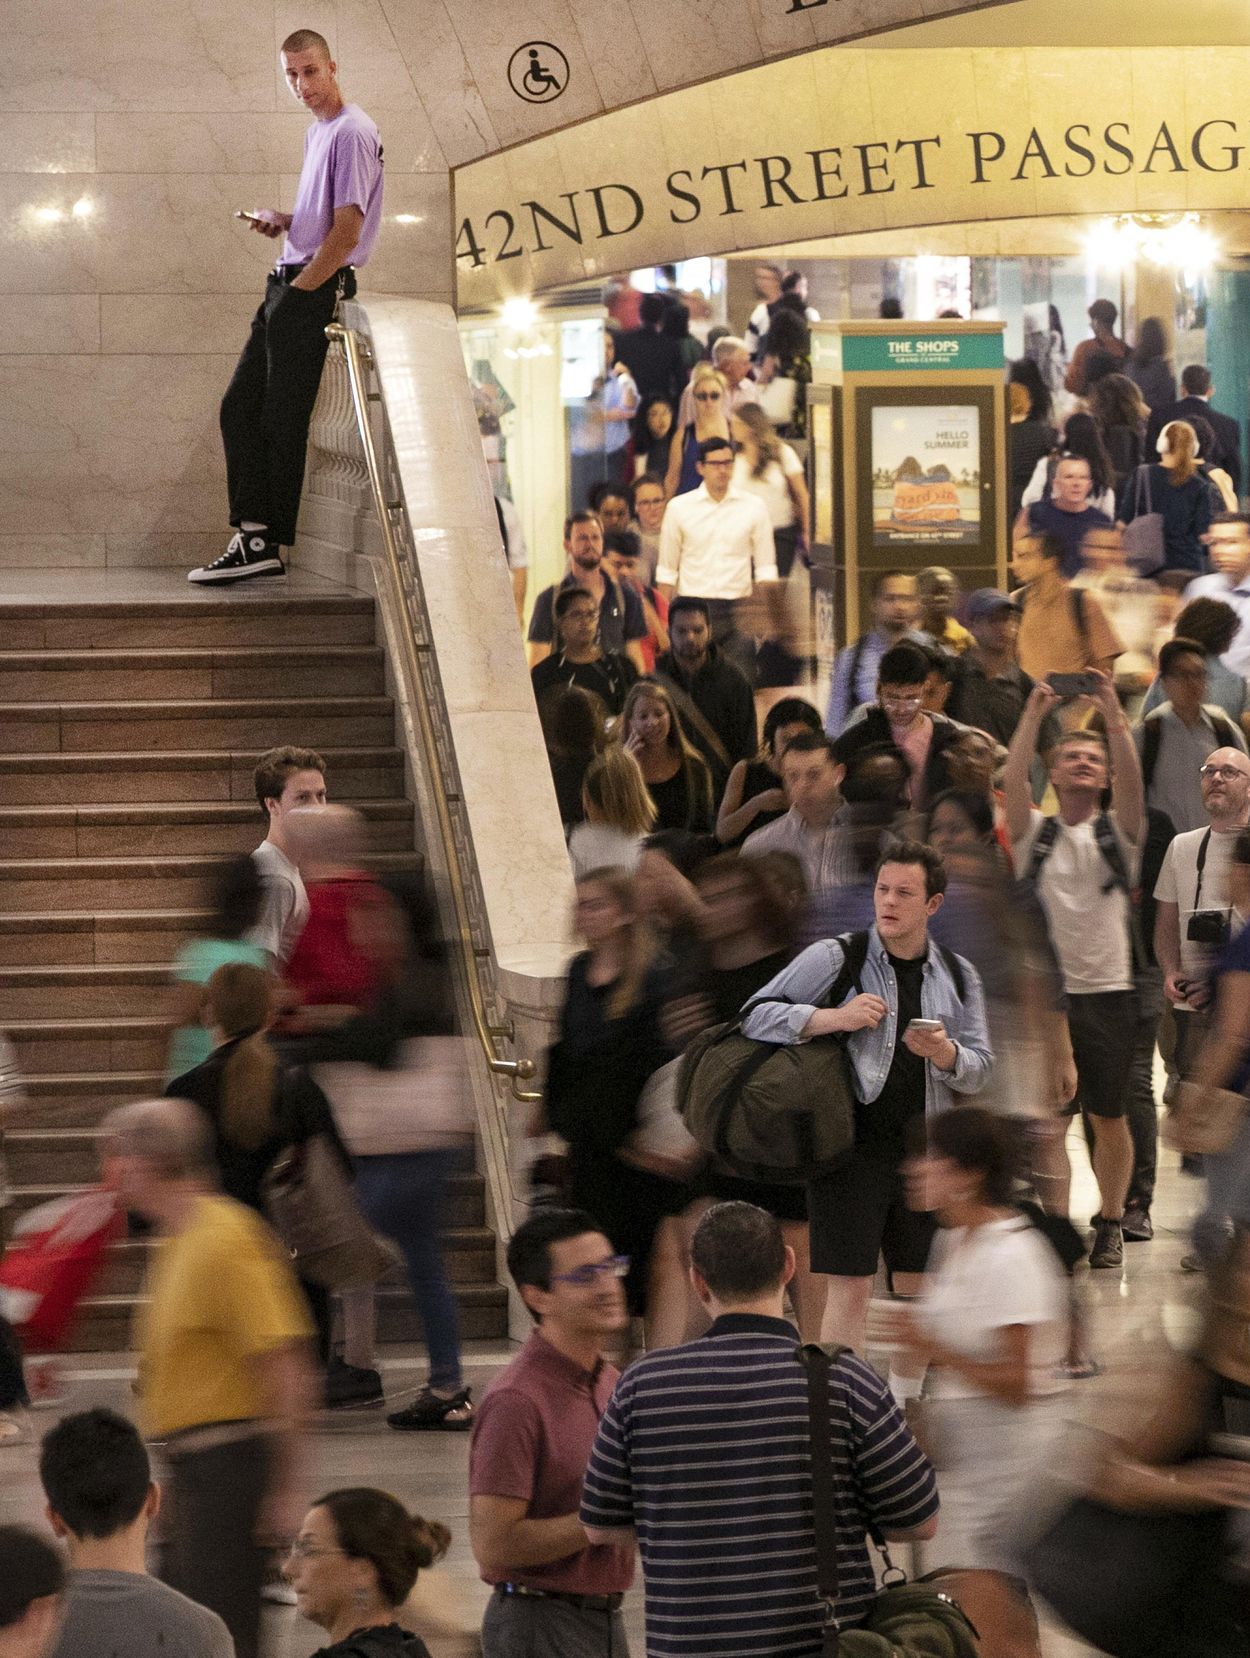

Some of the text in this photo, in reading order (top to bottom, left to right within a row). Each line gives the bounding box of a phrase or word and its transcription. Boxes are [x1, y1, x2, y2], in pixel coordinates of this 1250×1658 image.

[456, 184, 644, 268] 42ND
[666, 137, 941, 224] STREET
[888, 340, 960, 353] THE SHOPS
[936, 430, 969, 439] HELLO
[924, 441, 969, 449] SUMMER
